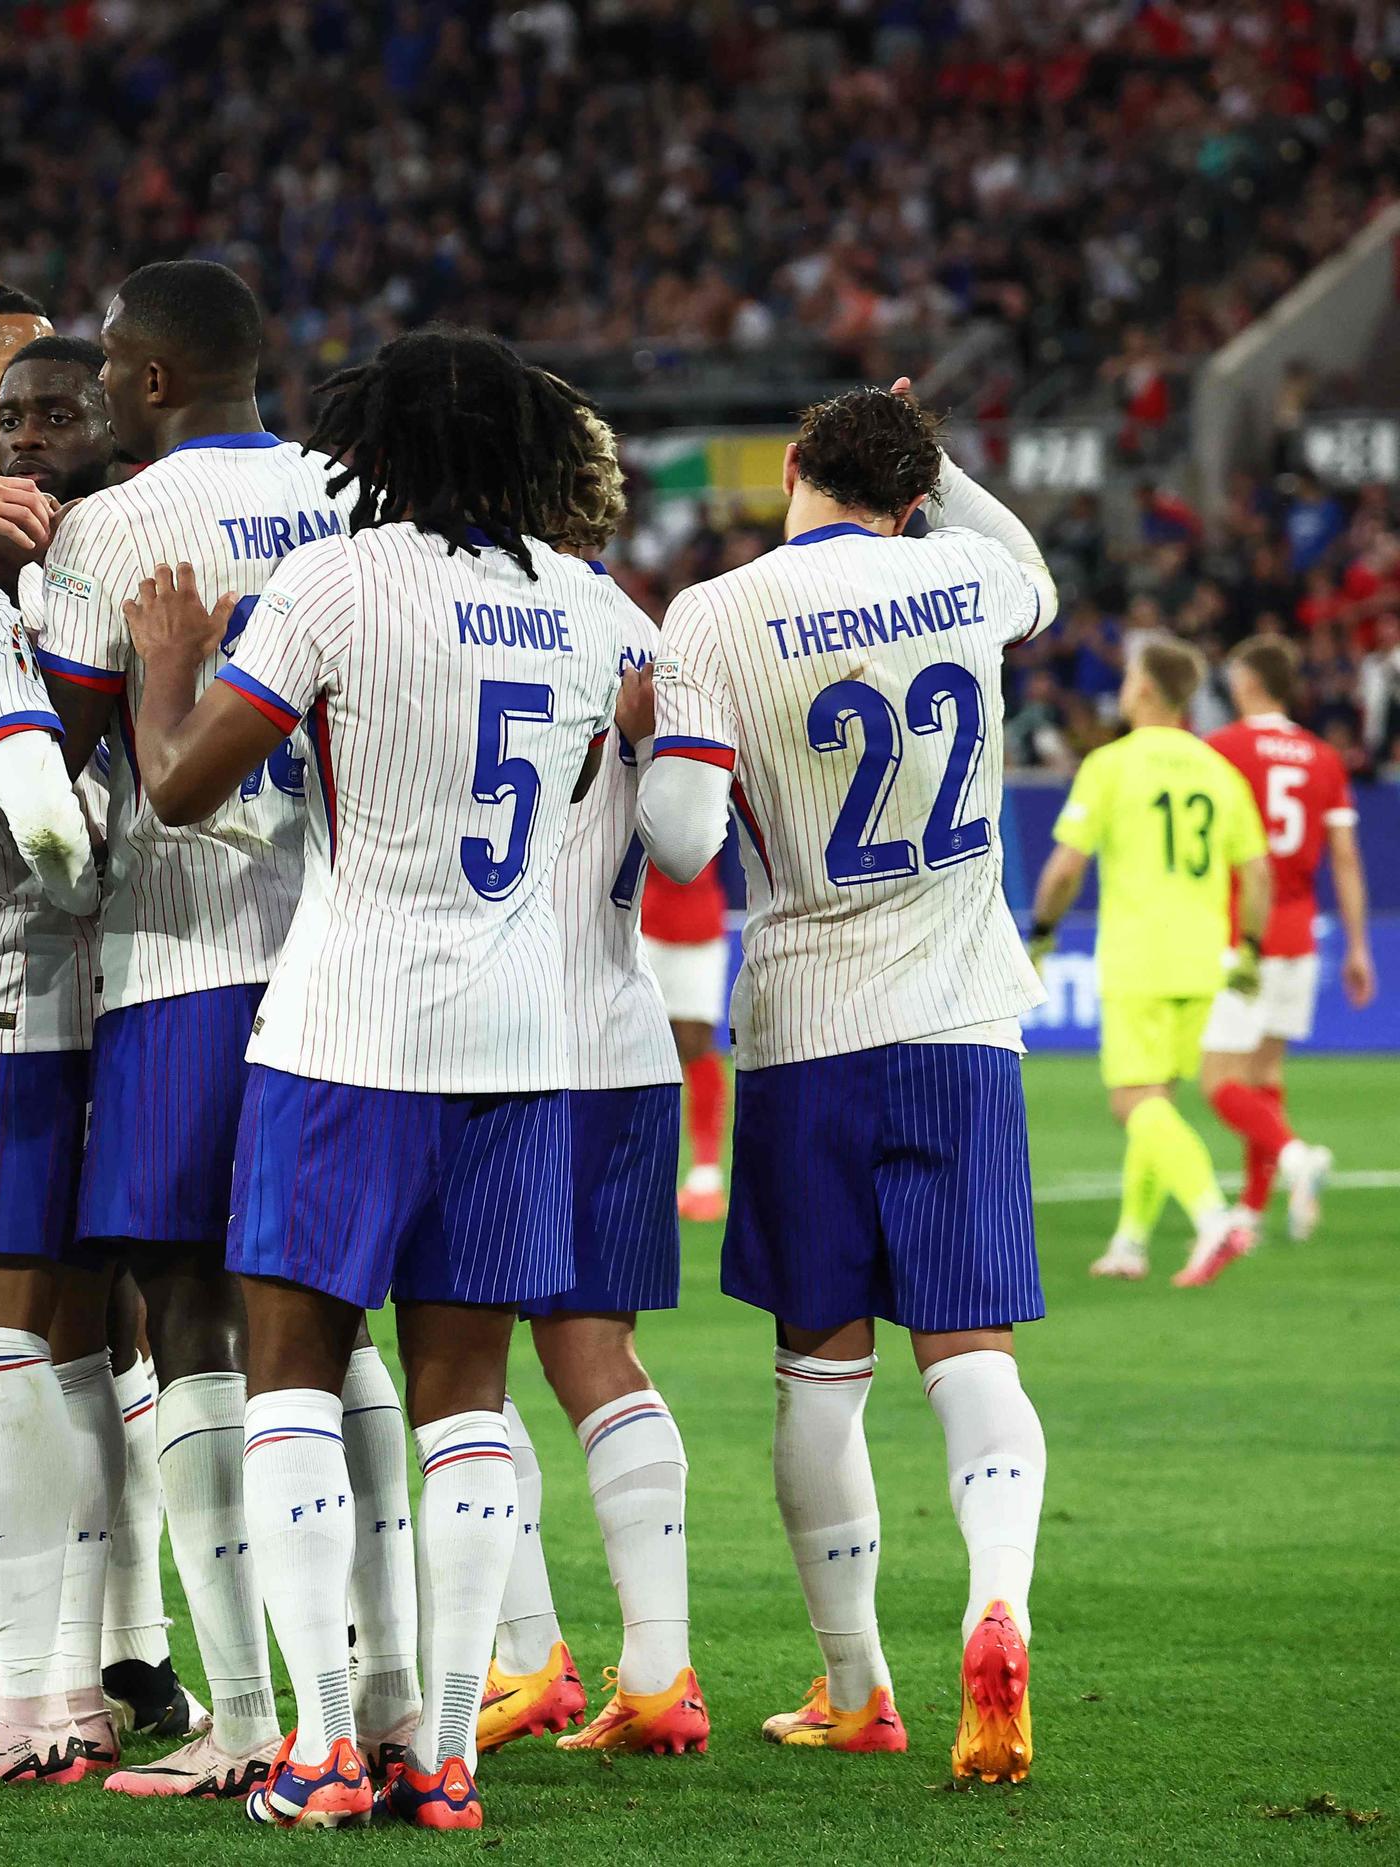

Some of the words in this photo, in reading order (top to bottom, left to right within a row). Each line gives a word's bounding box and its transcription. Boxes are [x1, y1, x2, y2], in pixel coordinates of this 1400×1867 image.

[219, 510, 341, 560] THURAM
[455, 601, 573, 652] KOUNDE
[767, 582, 985, 660] T.HERNANDEZ
[460, 679, 555, 902] 5
[807, 661, 992, 888] 22
[1266, 763, 1310, 858] 5
[1151, 790, 1215, 878] 13
